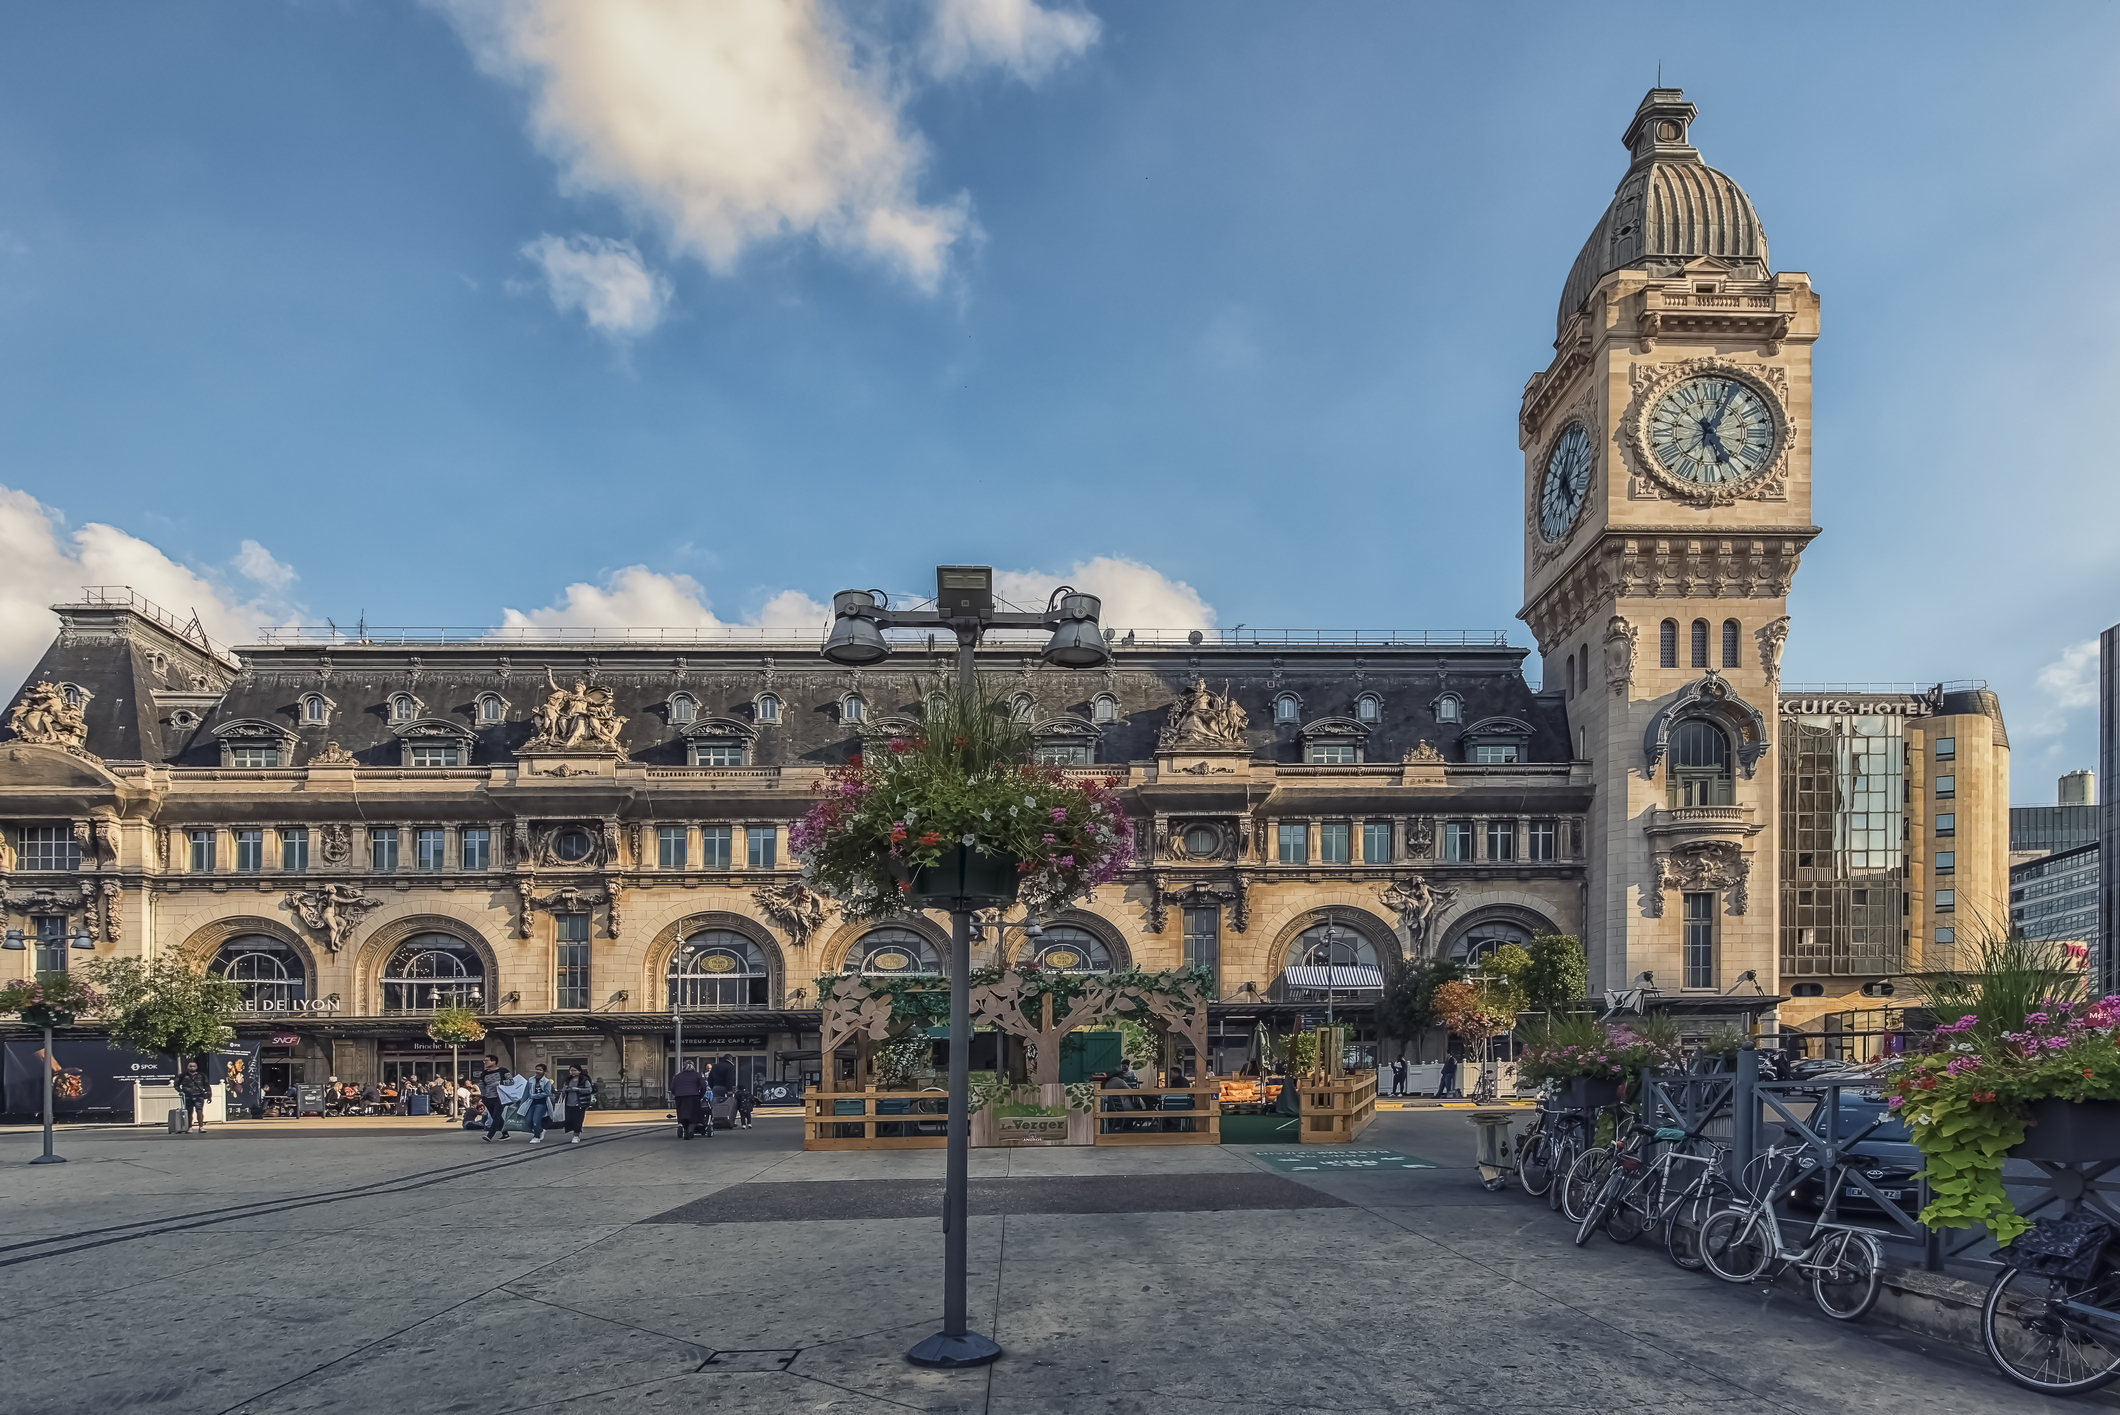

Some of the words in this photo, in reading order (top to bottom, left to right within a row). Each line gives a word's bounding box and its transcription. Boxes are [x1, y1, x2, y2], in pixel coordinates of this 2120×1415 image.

[263, 1000, 285, 1011] DE
[293, 1000, 340, 1011] LYON
[272, 1036, 298, 1044] SNCF
[1013, 1120, 1064, 1132] Verger
